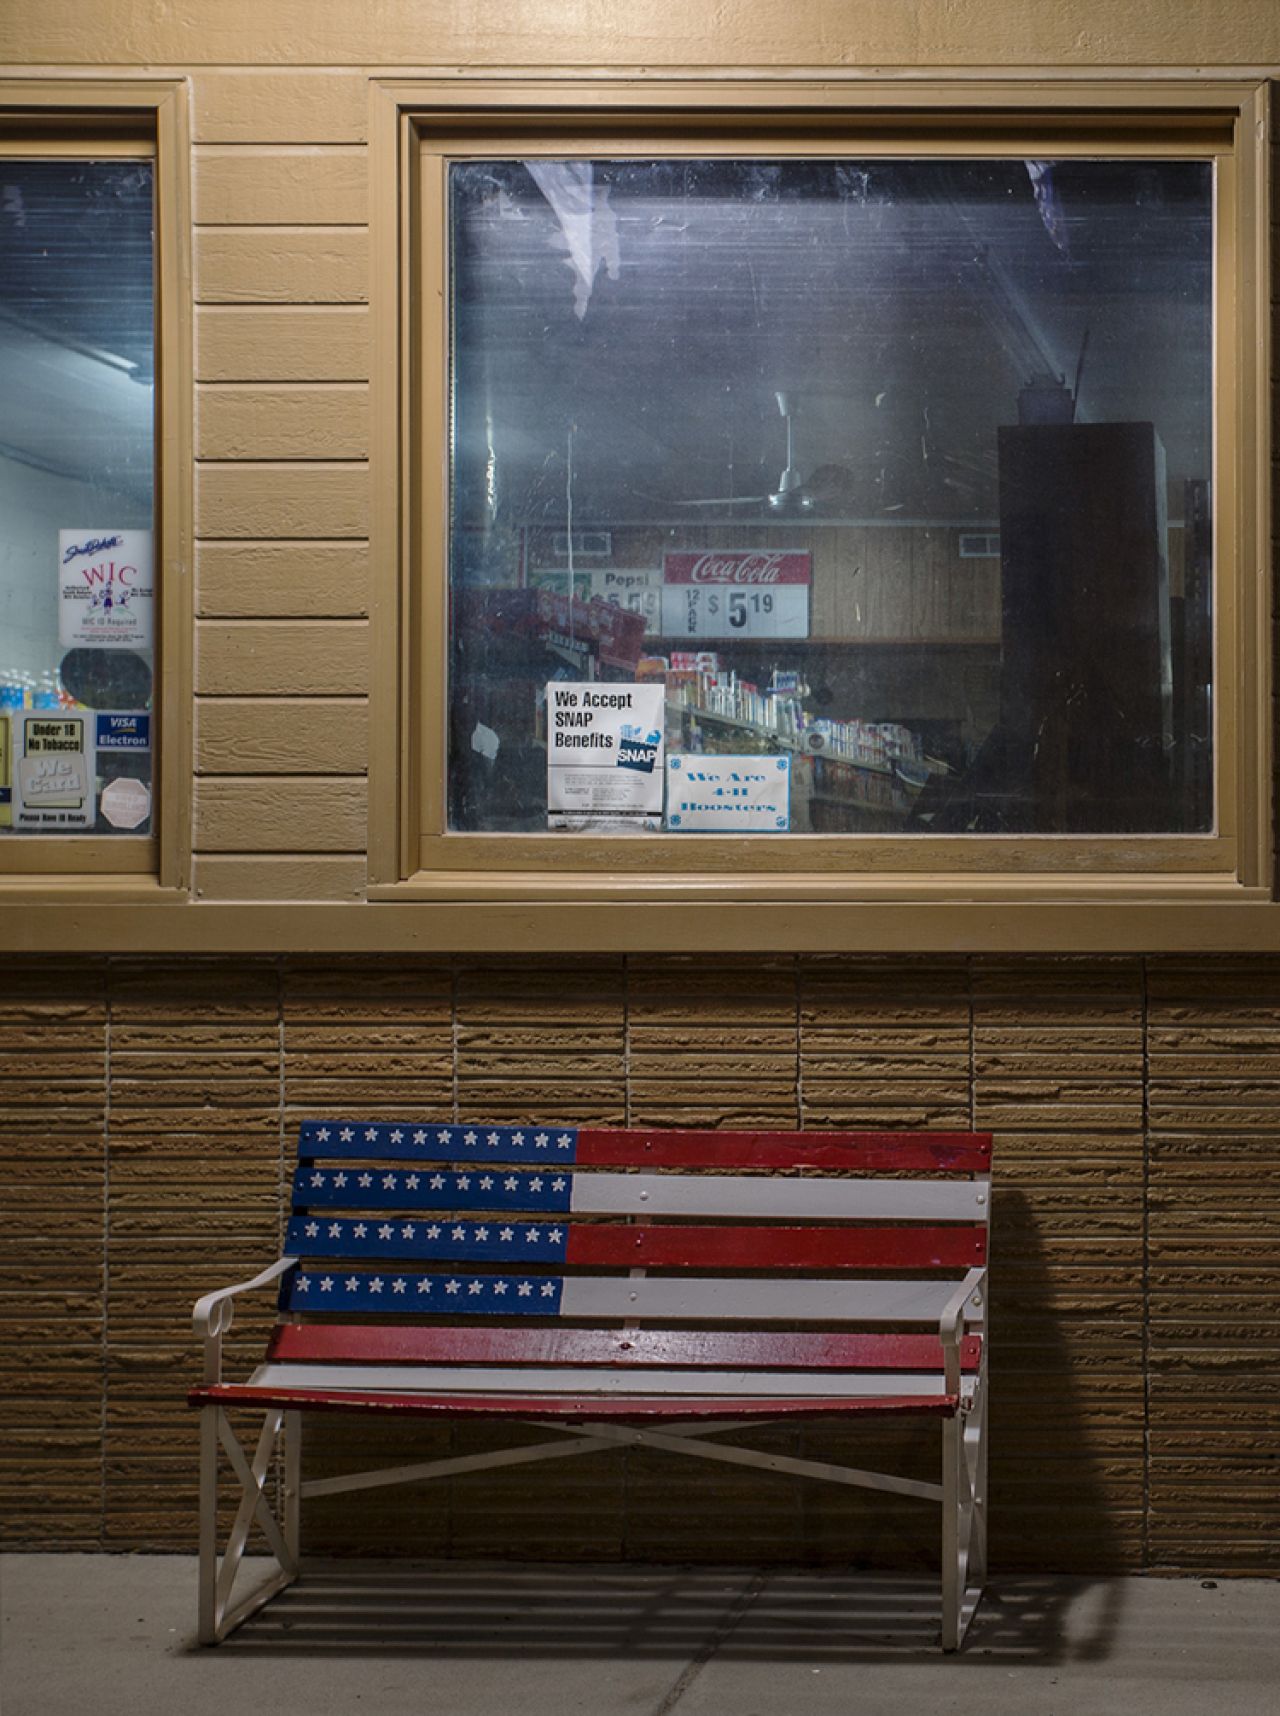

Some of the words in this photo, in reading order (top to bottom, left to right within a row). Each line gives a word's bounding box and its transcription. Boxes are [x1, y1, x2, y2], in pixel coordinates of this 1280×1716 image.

[82, 561, 138, 587] WIC
[691, 553, 785, 583] Coca-Cola
[605, 573, 650, 588] Pepsi
[555, 690, 578, 707] We
[582, 691, 632, 710] Accept
[110, 717, 138, 728] VISA
[555, 711, 593, 728] SNAP
[33, 724, 62, 736] Under
[65, 724, 76, 736] 18
[29, 738, 40, 750] No
[42, 738, 80, 751] Tobacco
[99, 735, 147, 746] Electron
[555, 731, 614, 748] Benefits
[617, 748, 657, 763] SNAP
